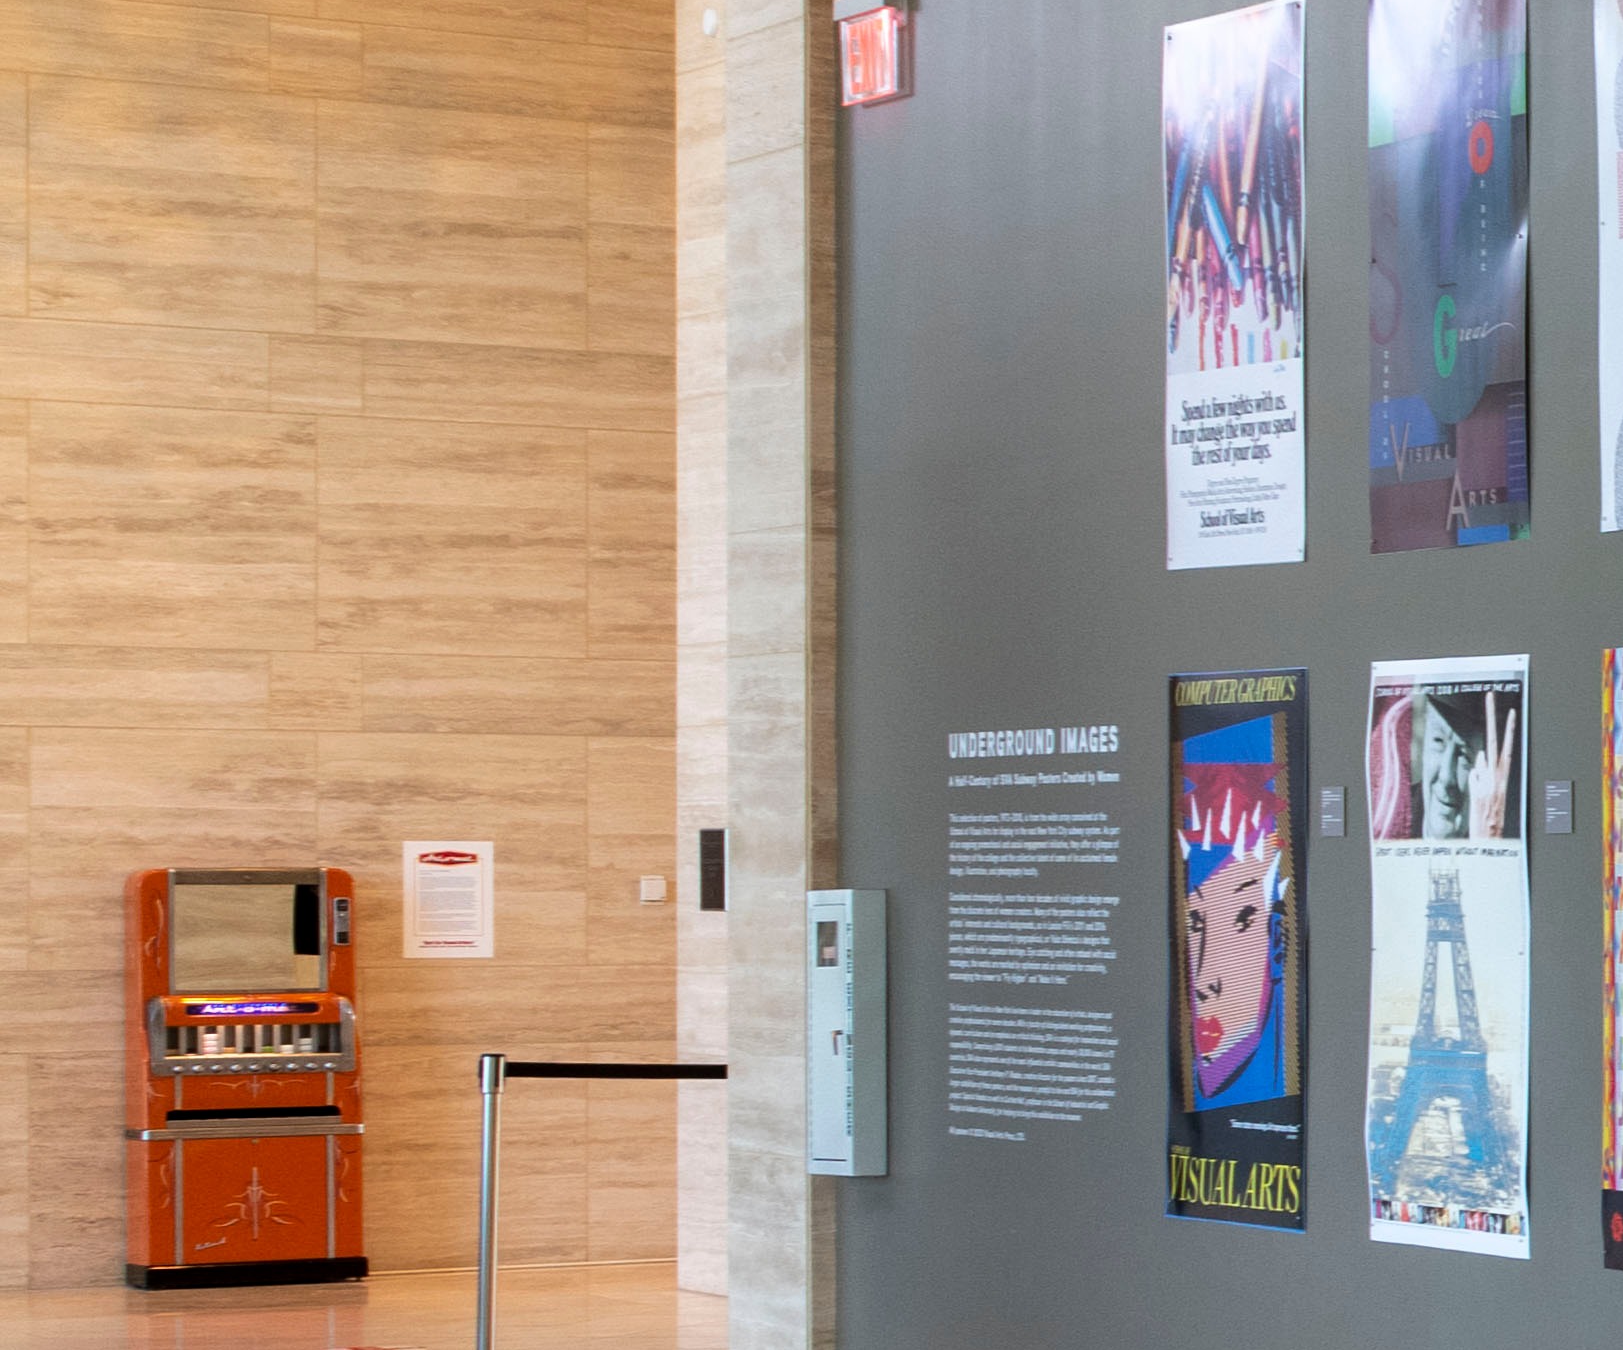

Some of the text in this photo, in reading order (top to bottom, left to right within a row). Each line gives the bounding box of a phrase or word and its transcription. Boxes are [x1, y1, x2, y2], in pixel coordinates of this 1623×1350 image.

[1446, 468, 1497, 530] ARTS
[1176, 674, 1296, 706] COMPUTER GRAPHICS
[949, 725, 1119, 758] UNDERGROUND IMAGES
[1168, 1154, 1301, 1213] VISUAL ARTS
